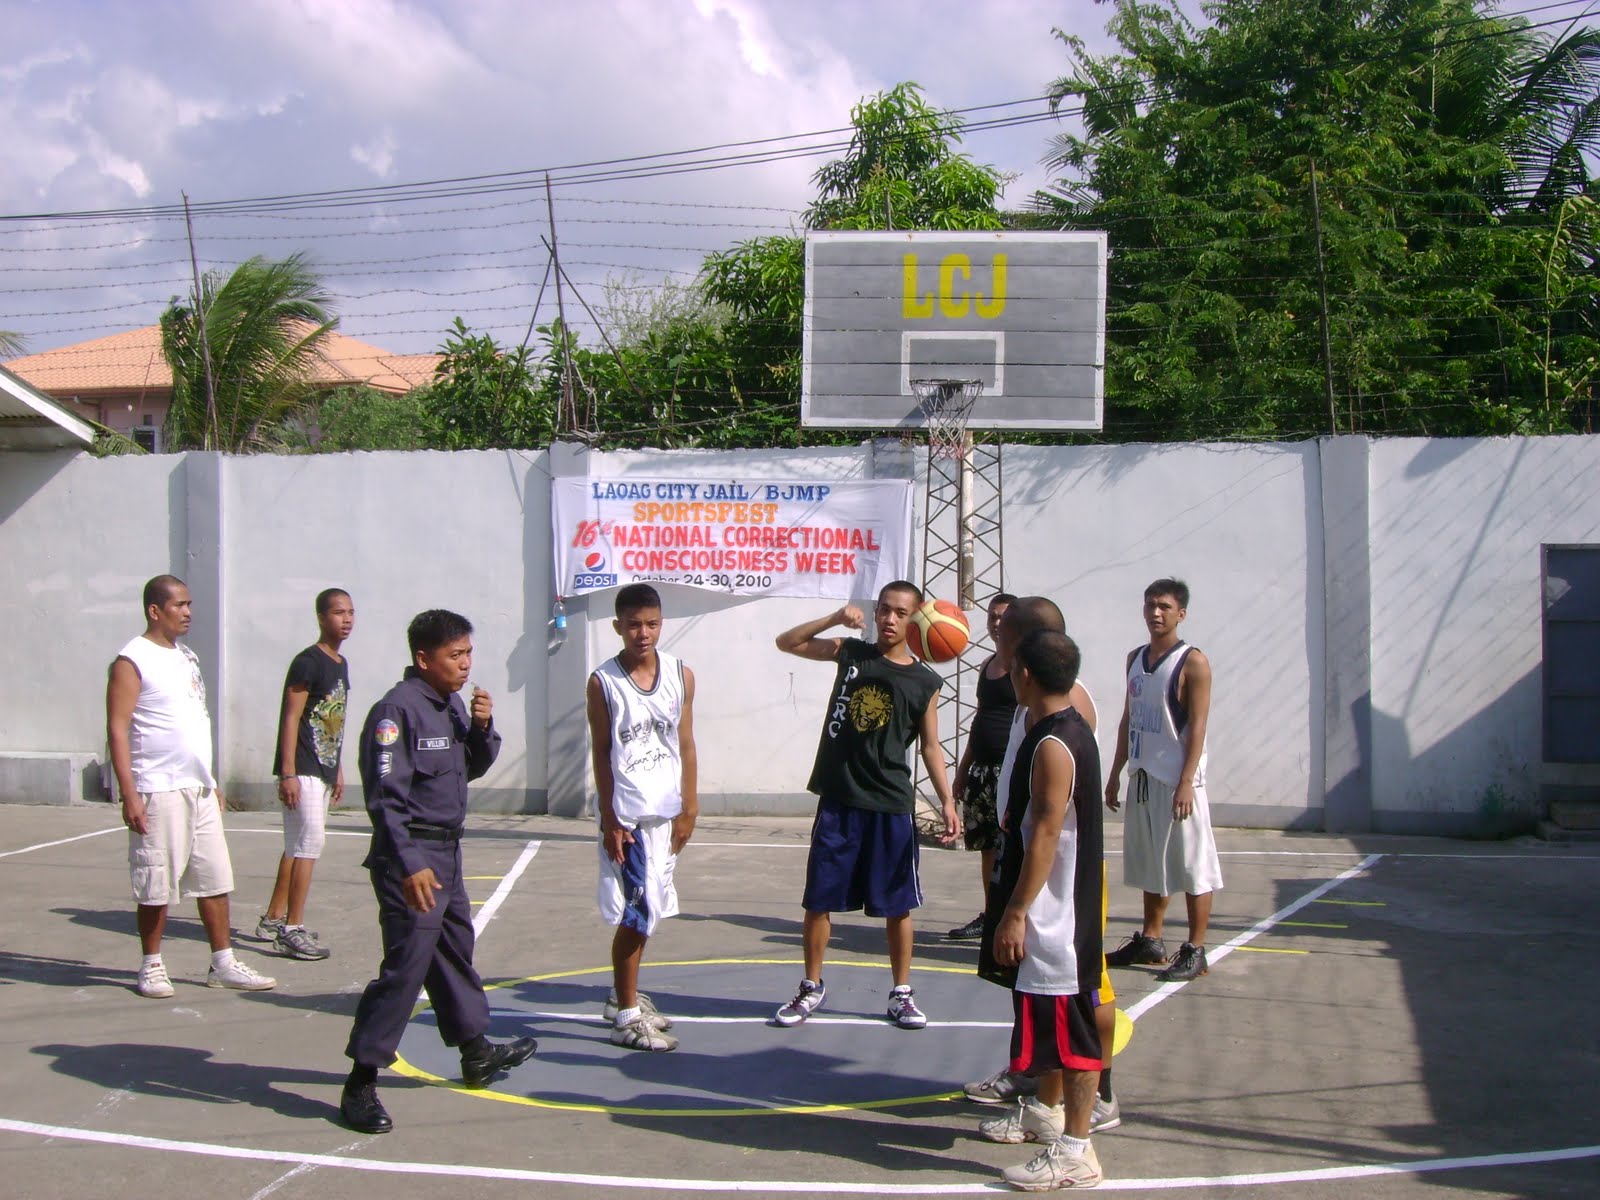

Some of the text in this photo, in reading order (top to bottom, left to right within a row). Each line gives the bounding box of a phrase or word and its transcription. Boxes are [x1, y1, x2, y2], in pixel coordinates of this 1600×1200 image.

[902, 253, 1008, 319] LCJ
[592, 482, 651, 499] LAOAG
[656, 483, 700, 500] CITY
[633, 502, 778, 524] SPORTSFEST
[613, 525, 718, 548] NATIONAL
[723, 526, 880, 551] CORRECTIONAL
[622, 550, 856, 574] CONSCIOUSNESS WEEK
[574, 575, 614, 588] pepsi
[735, 574, 772, 588] 2010
